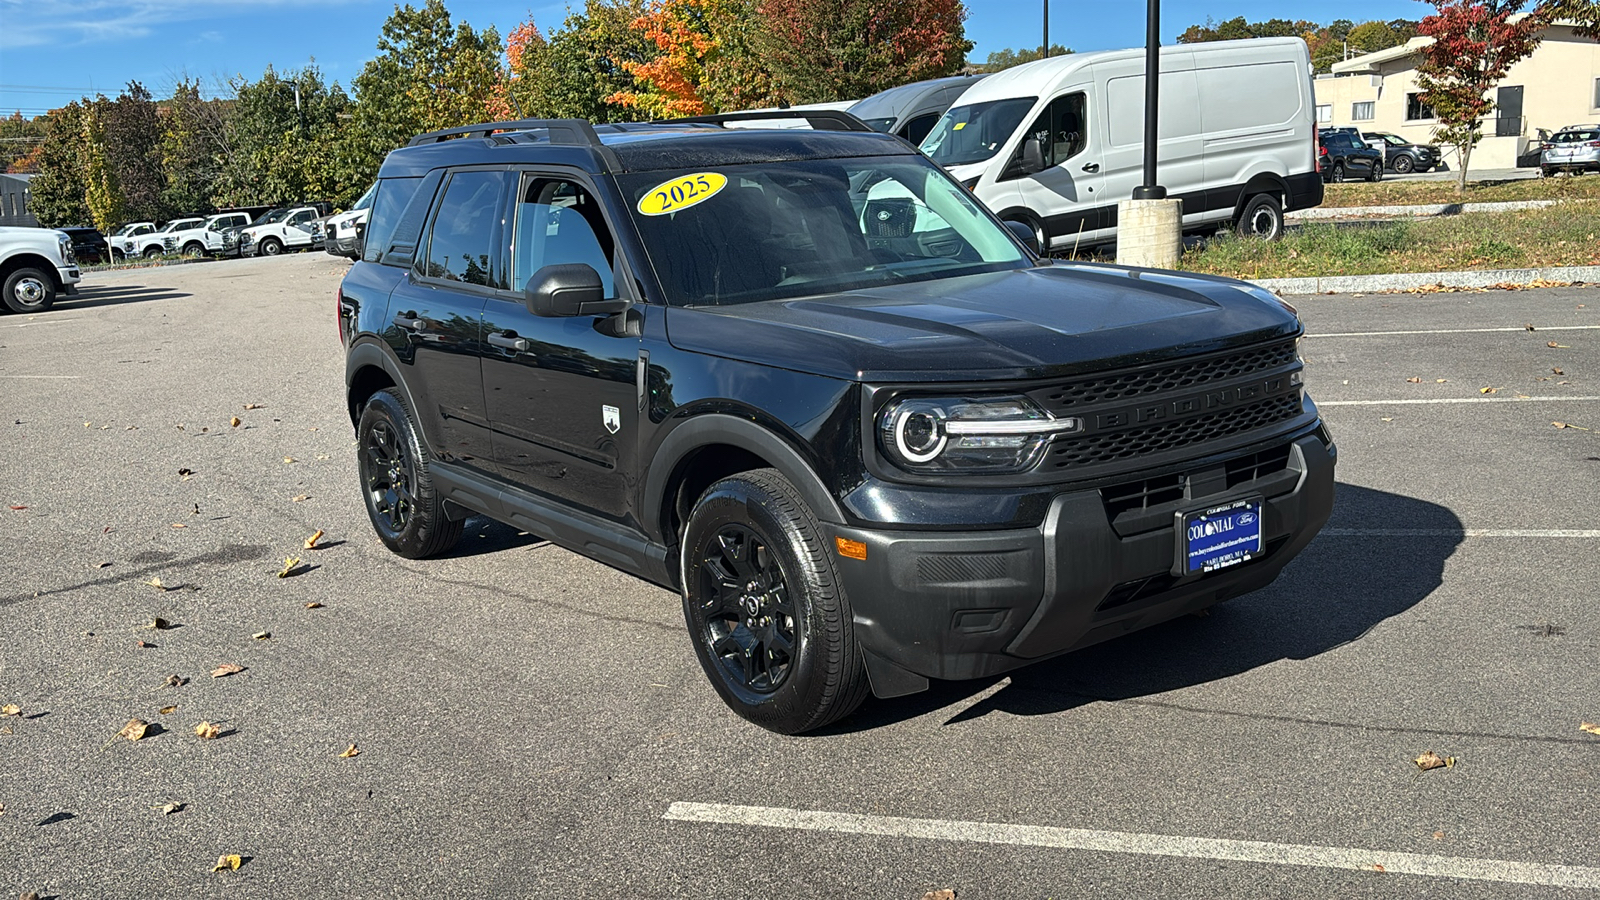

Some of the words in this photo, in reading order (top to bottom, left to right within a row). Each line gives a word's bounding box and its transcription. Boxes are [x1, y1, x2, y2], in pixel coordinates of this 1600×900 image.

[656, 175, 710, 210] 2025
[1096, 377, 1285, 429] BRONCO
[1187, 516, 1235, 541] COLONIAL
